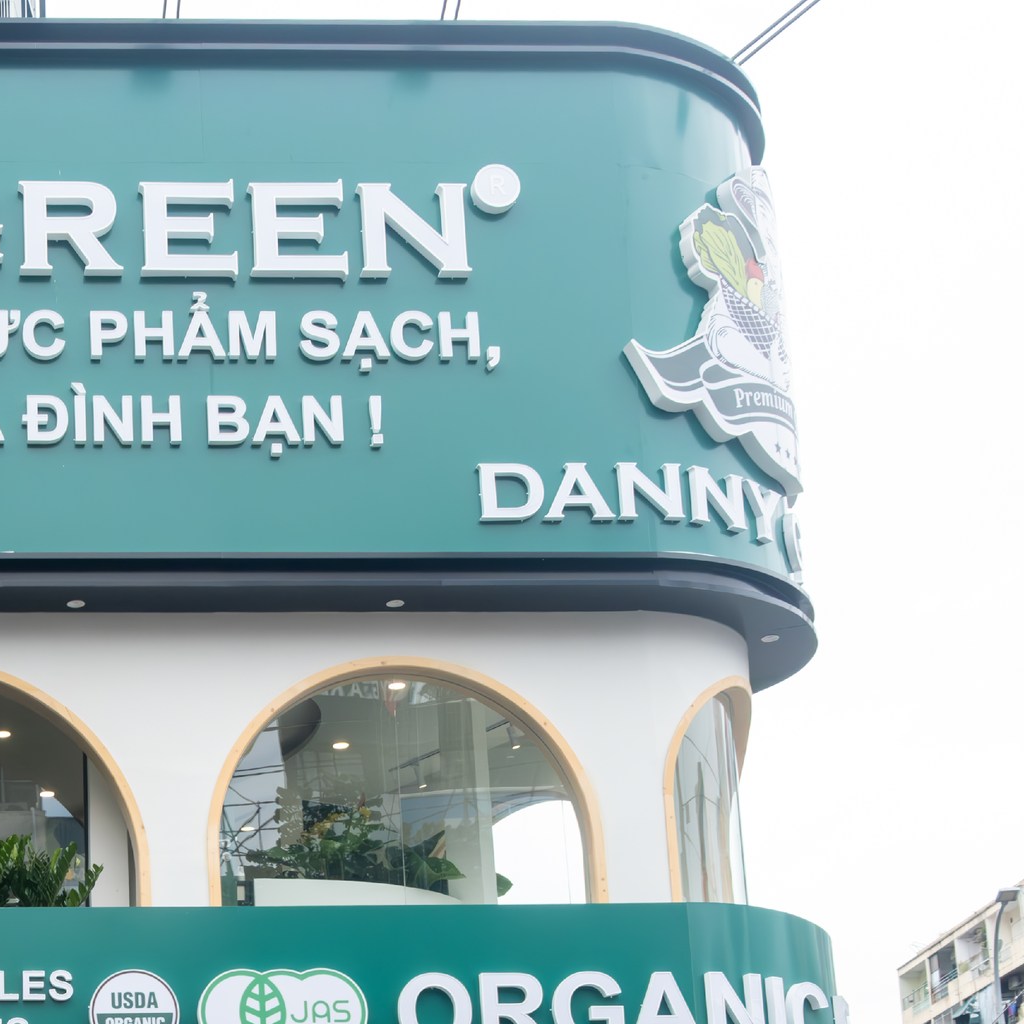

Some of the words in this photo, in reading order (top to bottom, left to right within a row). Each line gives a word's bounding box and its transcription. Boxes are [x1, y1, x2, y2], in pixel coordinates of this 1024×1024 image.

[89, 291, 278, 360] PHẨM
[299, 309, 501, 372] SẠCH,
[733, 387, 794, 415] Premium
[22, 382, 181, 446] ĐÌNH
[206, 394, 344, 457] BẠN
[111, 991, 159, 1010] USDA
[290, 1000, 351, 1024] JAS
